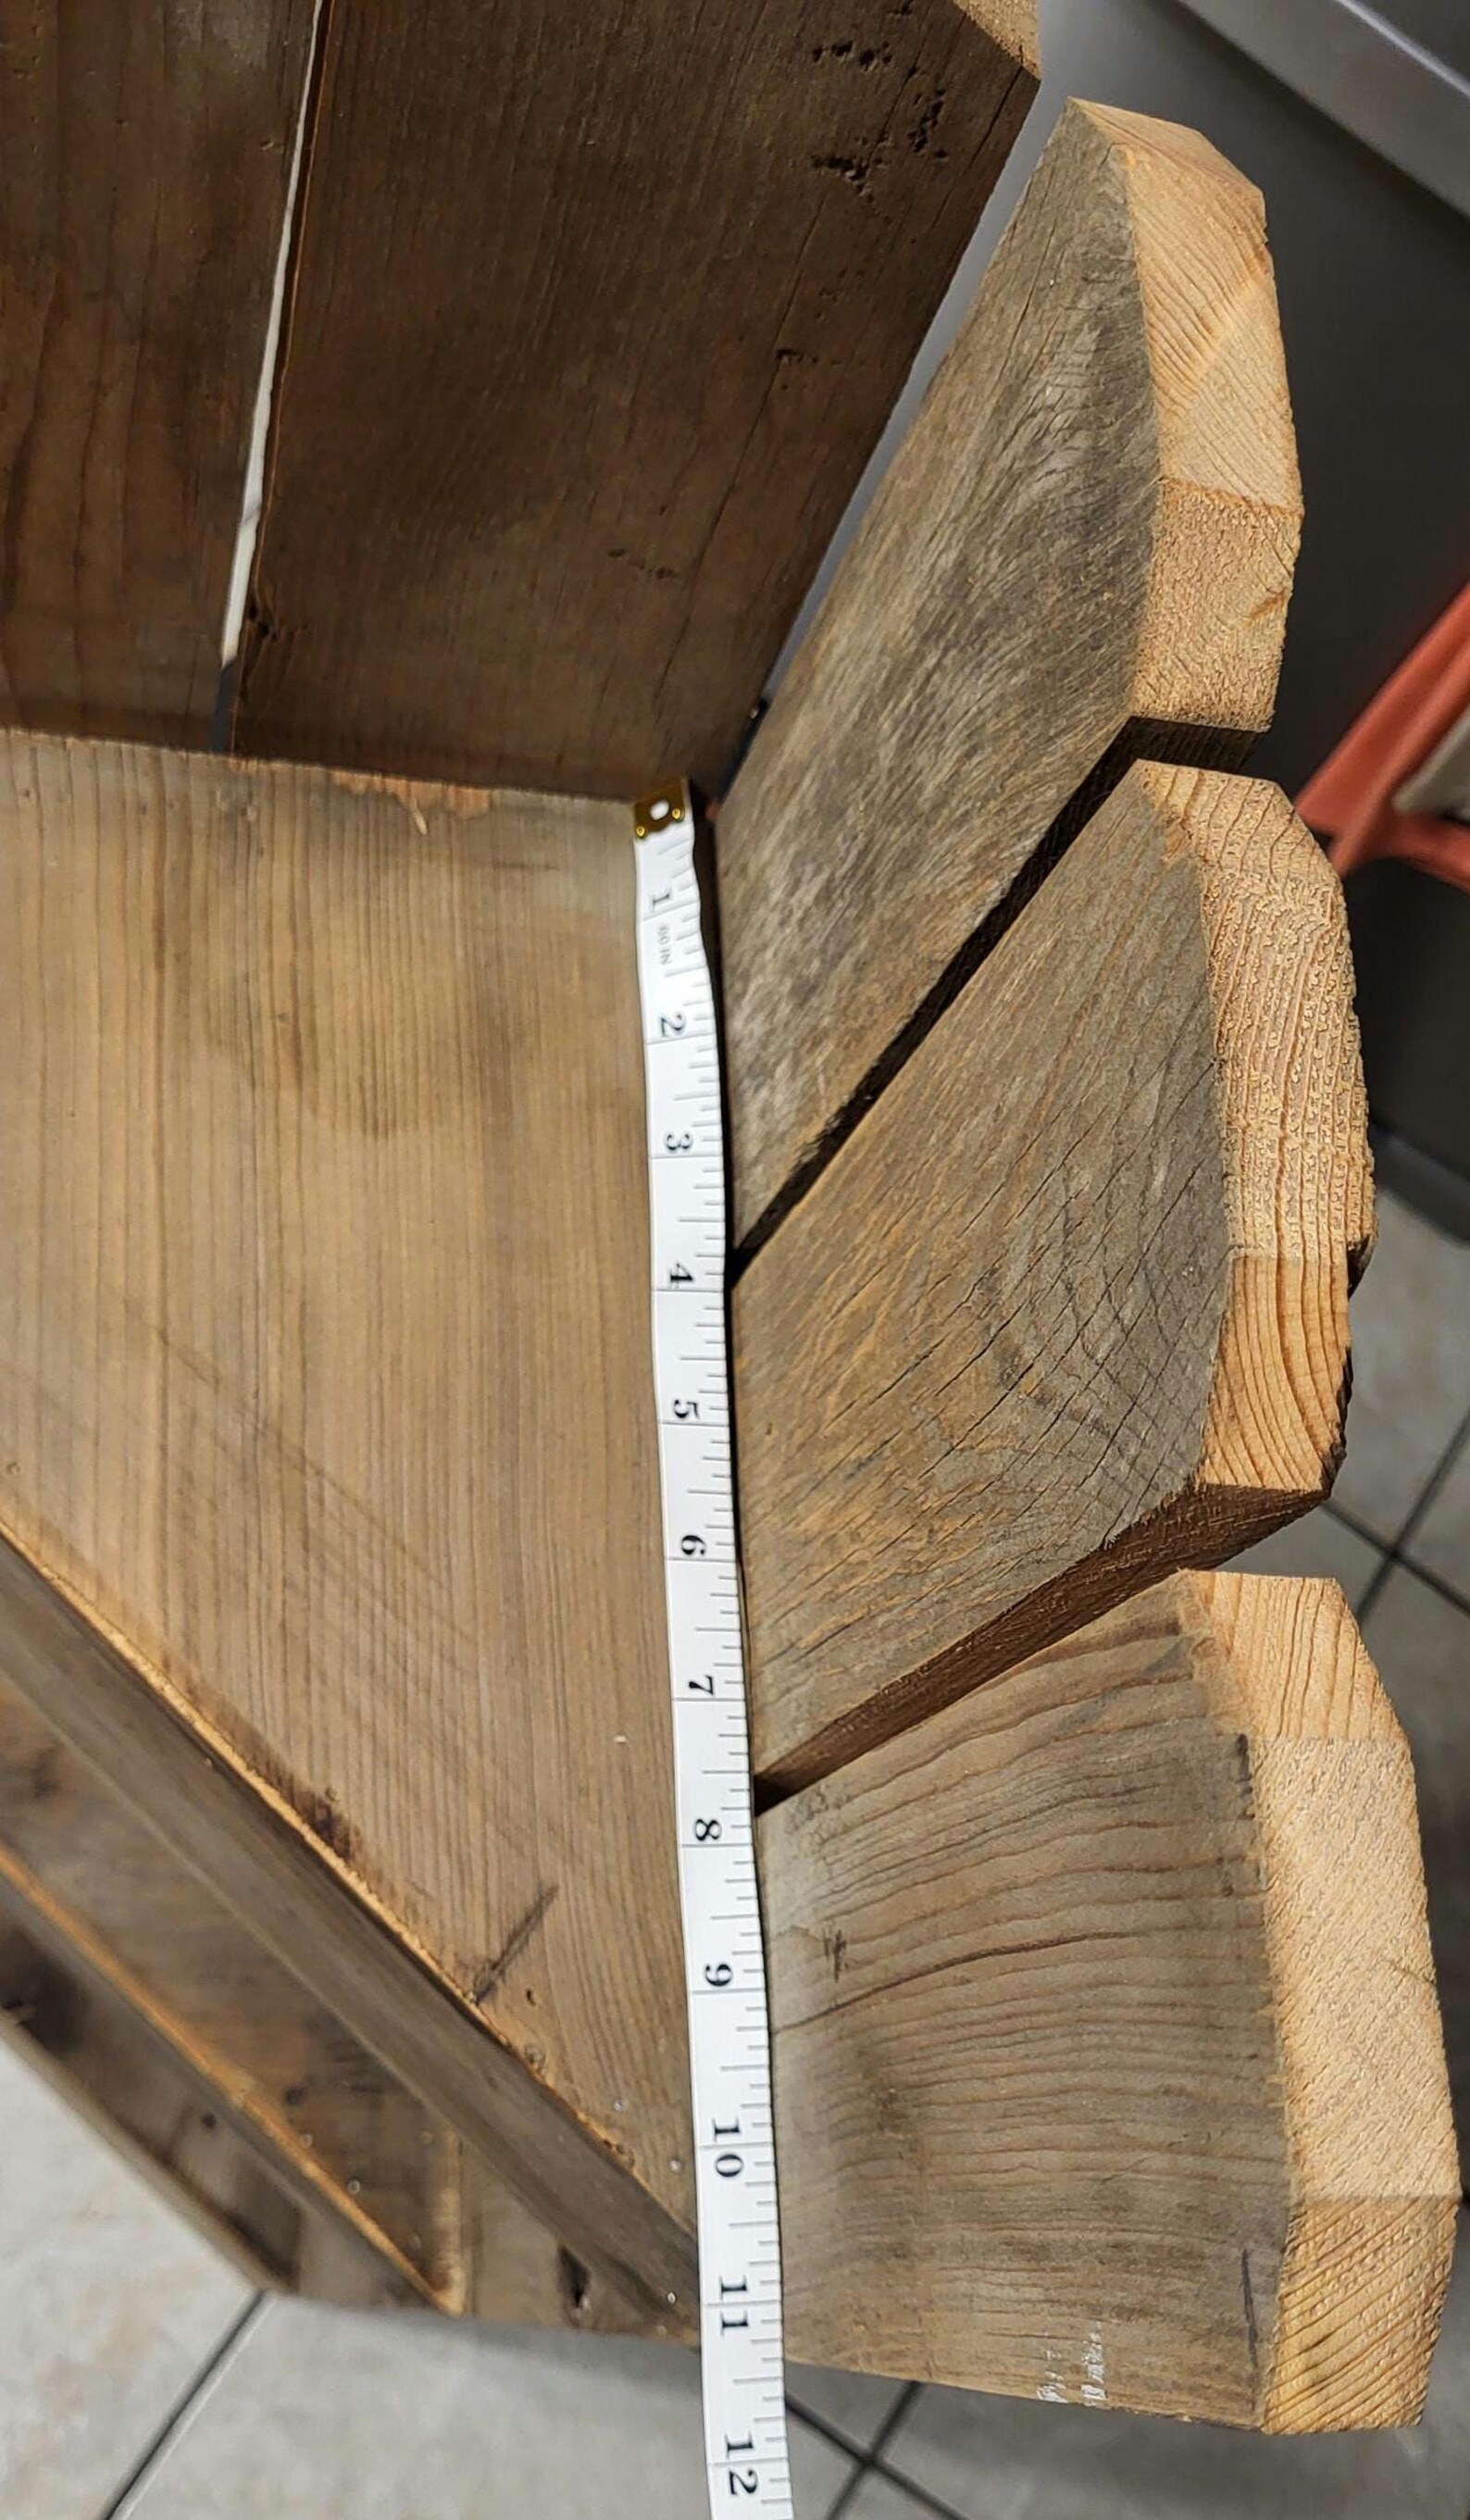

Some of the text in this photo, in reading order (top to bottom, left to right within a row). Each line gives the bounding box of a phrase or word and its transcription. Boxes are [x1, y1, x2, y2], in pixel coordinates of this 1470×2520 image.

[651, 886, 671, 911] 1
[660, 1014, 684, 1036] 2
[666, 1132, 691, 1153] 3
[669, 1263, 693, 1286] 4
[673, 1399, 699, 1420] 5
[680, 1534, 706, 1556] 6
[688, 1675, 715, 1696] 7
[694, 1817, 721, 1842] 8
[704, 1963, 732, 1988] 9
[714, 2119, 743, 2178] 10
[720, 2277, 749, 2336] 11
[726, 2435, 758, 2496] 12
